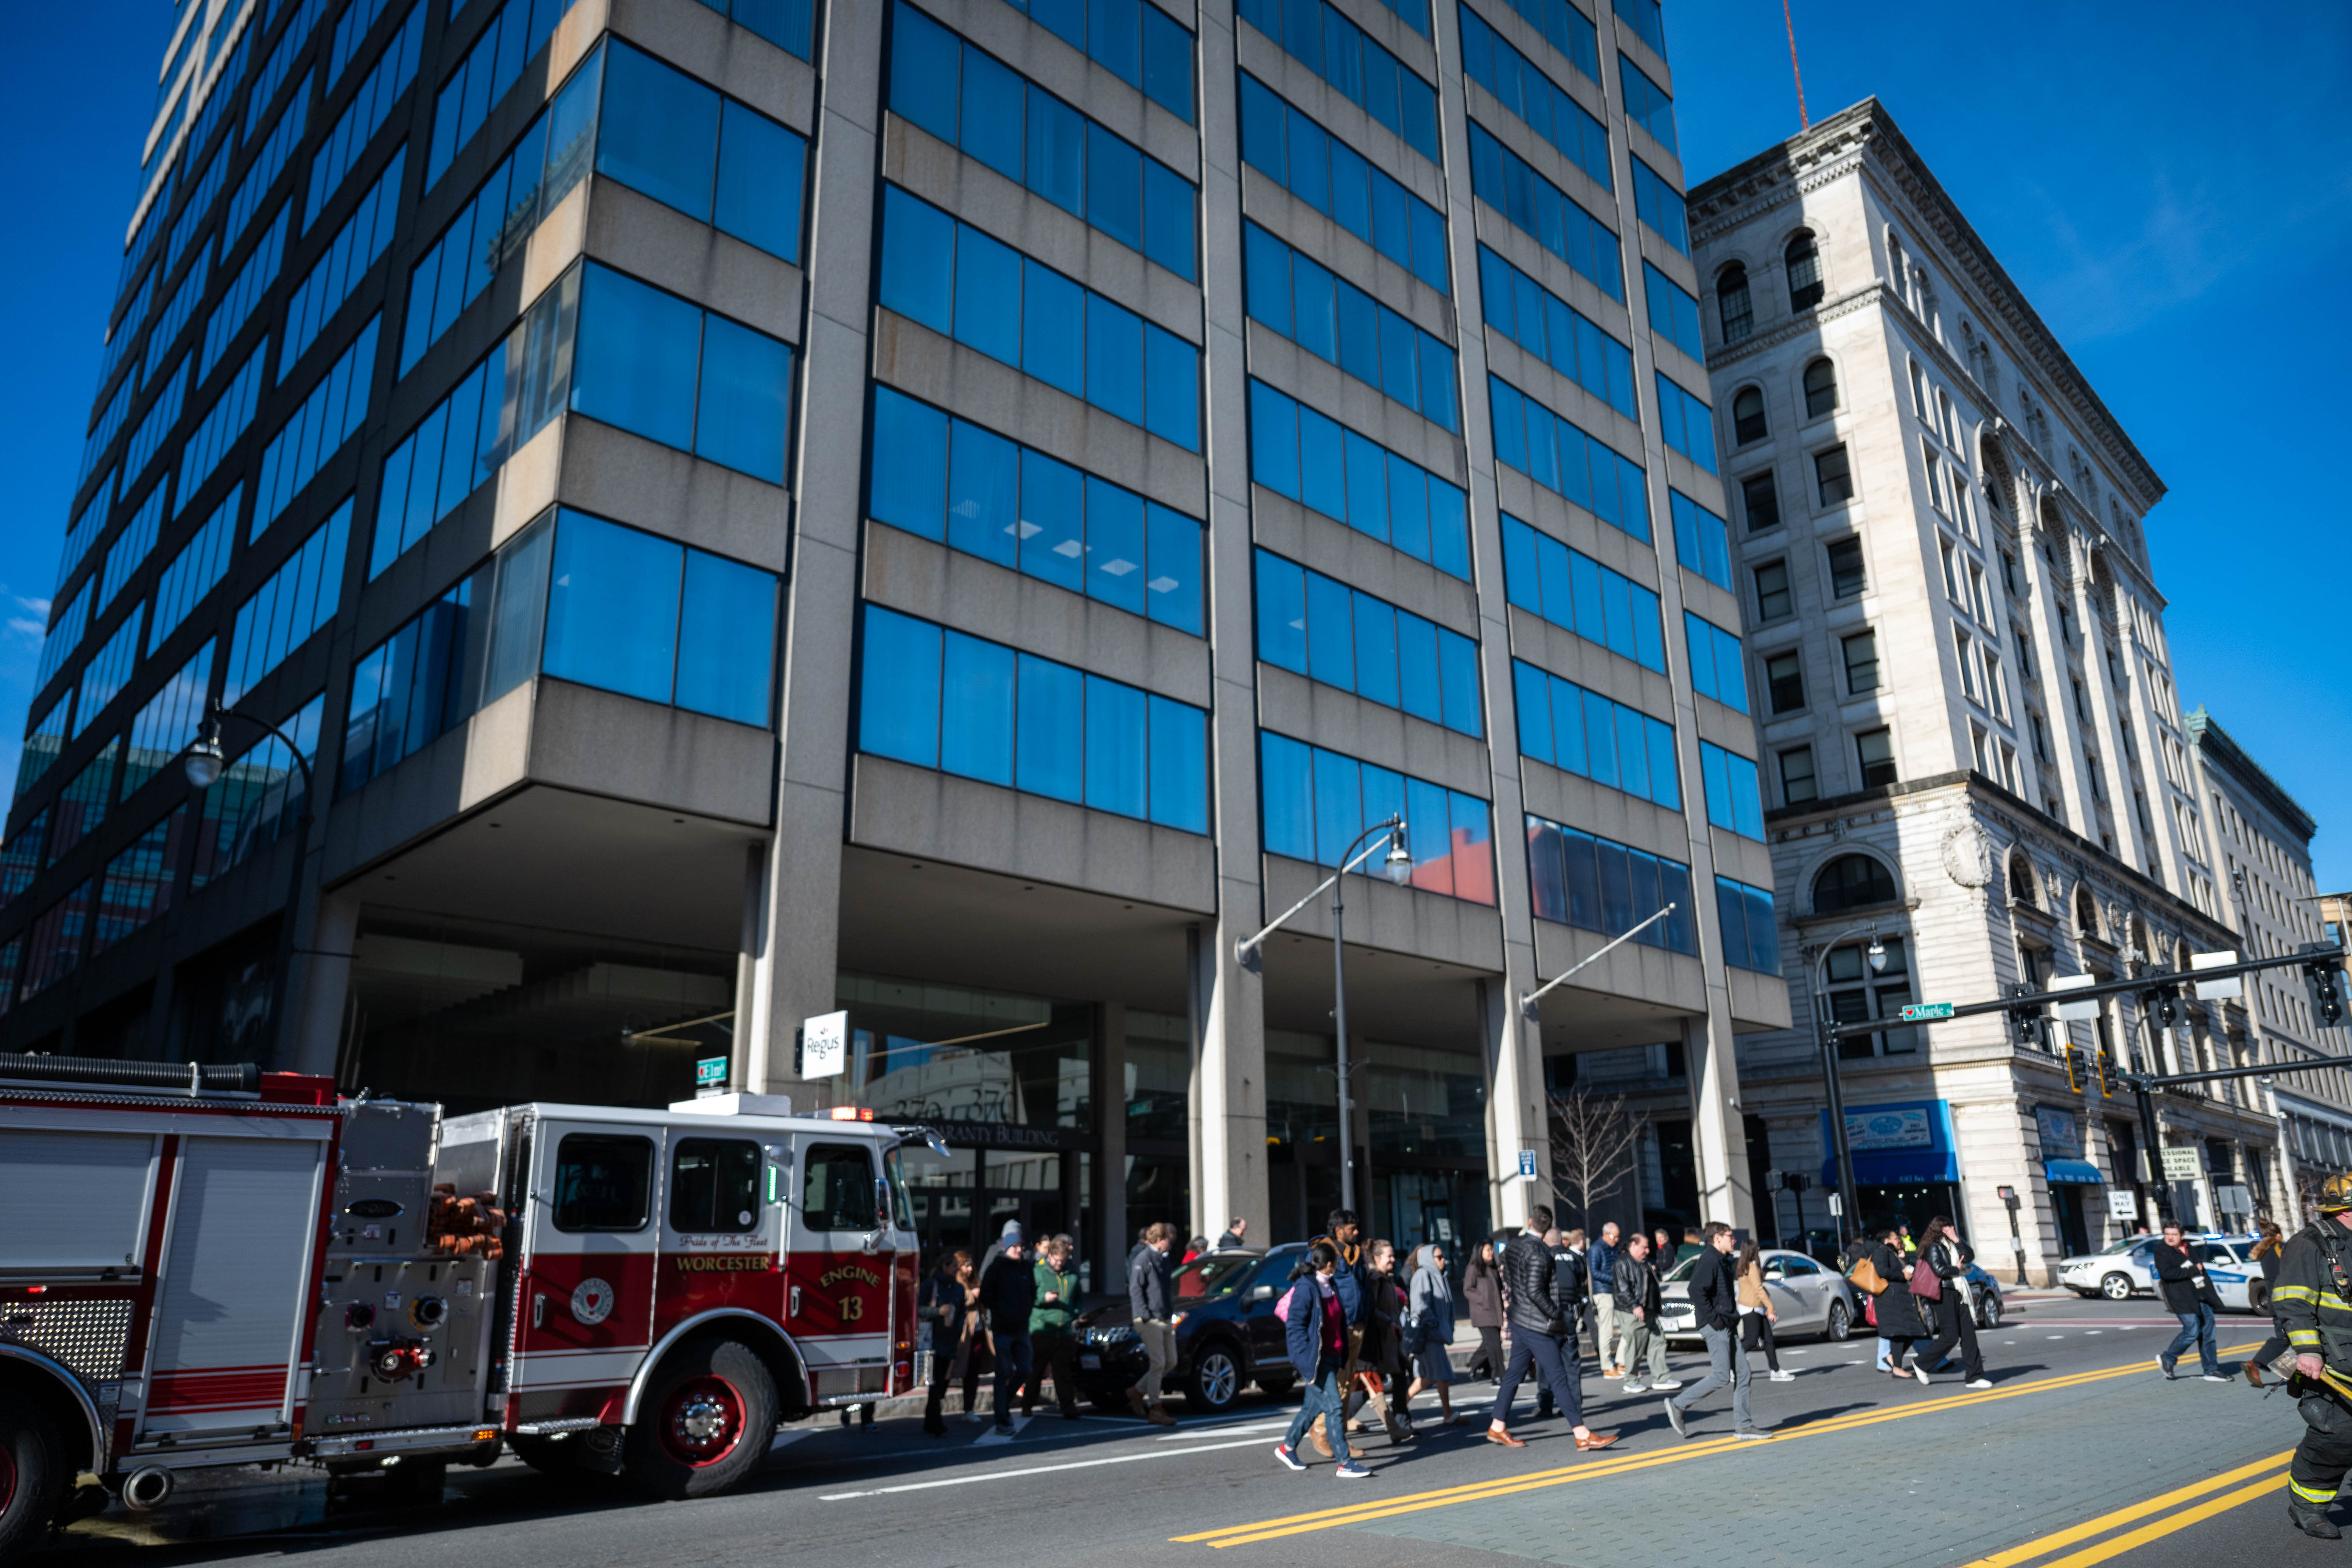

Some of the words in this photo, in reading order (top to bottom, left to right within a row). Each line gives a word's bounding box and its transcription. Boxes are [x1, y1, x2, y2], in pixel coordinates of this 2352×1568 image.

[1915, 1005, 1943, 1017] Maple
[807, 1036, 839, 1060] Regus
[704, 1064, 721, 1078] Elm
[968, 1089, 1014, 1123] 370
[679, 1234, 706, 1247] Pride
[710, 1234, 721, 1252] of
[723, 1234, 740, 1246] The
[744, 1234, 768, 1249] Fleet
[676, 1256, 769, 1272] WORCESTER
[819, 1265, 881, 1288] ENGINE
[838, 1295, 863, 1320] 13
